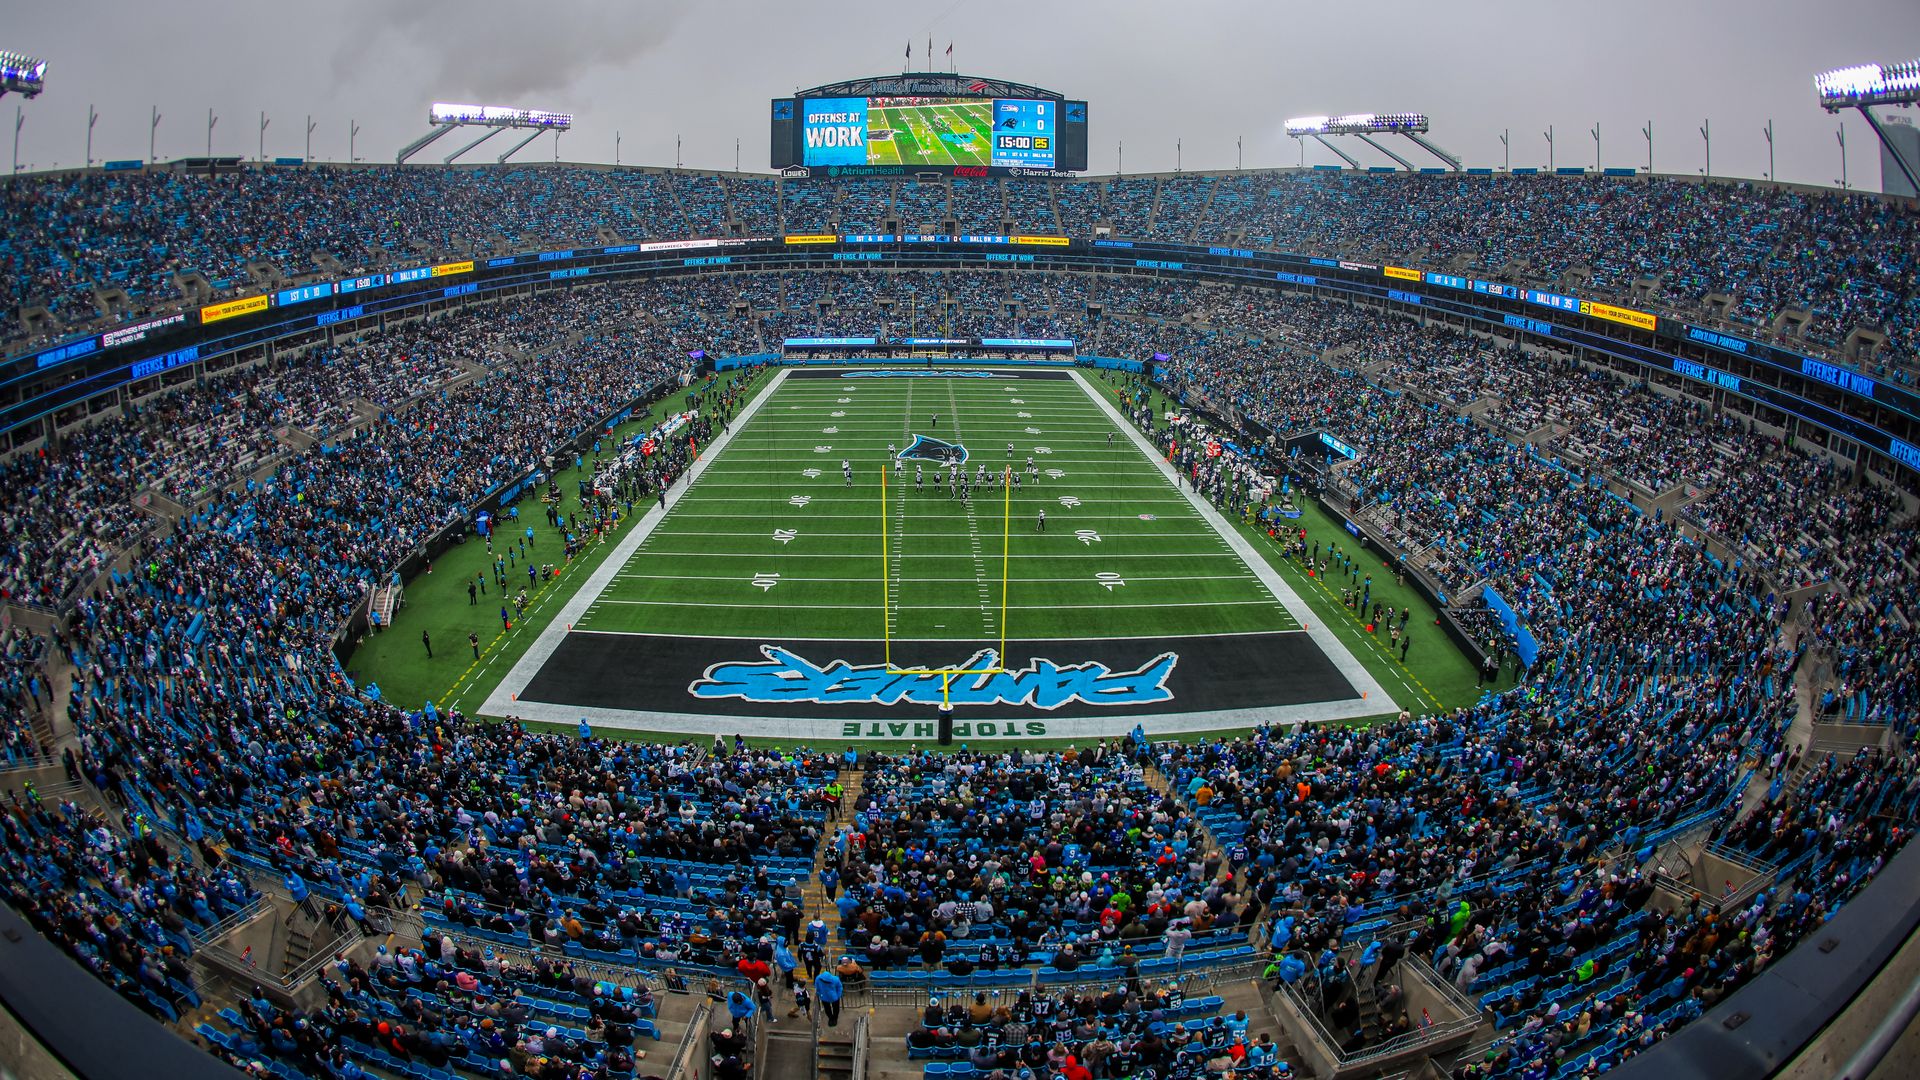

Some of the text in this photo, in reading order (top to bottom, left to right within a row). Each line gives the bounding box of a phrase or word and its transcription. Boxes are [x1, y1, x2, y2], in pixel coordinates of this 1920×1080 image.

[871, 82, 957, 93] Bank of America
[1037, 105, 1044, 115] 0
[809, 112, 860, 124] OFFENSE AT
[1037, 120, 1044, 130] 0
[806, 126, 864, 148] WORK
[1000, 136, 1030, 148] 15:00
[1034, 138, 1047, 148] 25
[841, 167, 904, 175] Atrium Health
[1023, 169, 1076, 178] Harris Teeter
[539, 250, 573, 262] OFFENSE AT WORK
[834, 253, 856, 261] OFFENSE
[1209, 248, 1230, 256] OFFENSE
[1240, 250, 1254, 258] WORK
[684, 257, 706, 266] OFFENSE
[1136, 260, 1158, 268] OFFENSE
[386, 274, 390, 284] 0
[400, 269, 426, 281] BALL ON 35
[550, 270, 567, 279] OFFENSE
[576, 267, 589, 275] WORK
[1277, 273, 1295, 282] OFFENSE
[1303, 276, 1316, 284] WORK
[334, 283, 338, 293] 0
[356, 278, 371, 288] 15:00
[290, 287, 320, 302] 1ST & 10
[444, 288, 460, 297] OFFENSE
[467, 284, 477, 292] WORK
[1388, 289, 1403, 300] OFFENSE
[1488, 284, 1502, 295] 15:00
[1520, 289, 1524, 300] 0
[1537, 293, 1572, 309] BALL ON 35
[232, 304, 245, 313] OFFICIAL
[1580, 302, 1589, 313] 25
[317, 306, 363, 324] OFFENSE AT WORK
[1618, 312, 1631, 321] OFFICIAL
[1632, 315, 1648, 325] TAILGATE
[113, 325, 138, 338] PANTHERS
[138, 322, 151, 332] FIRST
[152, 319, 162, 329] AND
[168, 317, 174, 325] AT
[175, 314, 184, 323] THE
[1504, 314, 1551, 334] OFFENSE AT WORK
[114, 335, 133, 345] 35-YARD
[1690, 329, 1747, 352] CAROLINA PANTHERS
[132, 346, 199, 378] OFFENSE AT WORK
[1673, 360, 1741, 391] OFFENSE AT WORK
[1802, 358, 1874, 397] OFFENSE AT WORK
[772, 529, 798, 541] 20
[1075, 530, 1101, 542] 20
[751, 573, 780, 587] 10
[1095, 572, 1125, 586] 10
[687, 644, 1179, 710] PANTHERS
[842, 722, 1046, 737] STOP HATE
[1069, 849, 1076, 858] 9
[1440, 913, 1449, 924] 31
[1034, 1002, 1050, 1014] 87
[1056, 1029, 1072, 1042] 89
[1212, 1037, 1224, 1046] 17
[1260, 1054, 1274, 1066] 19
[1176, 1069, 1190, 1078] 22
